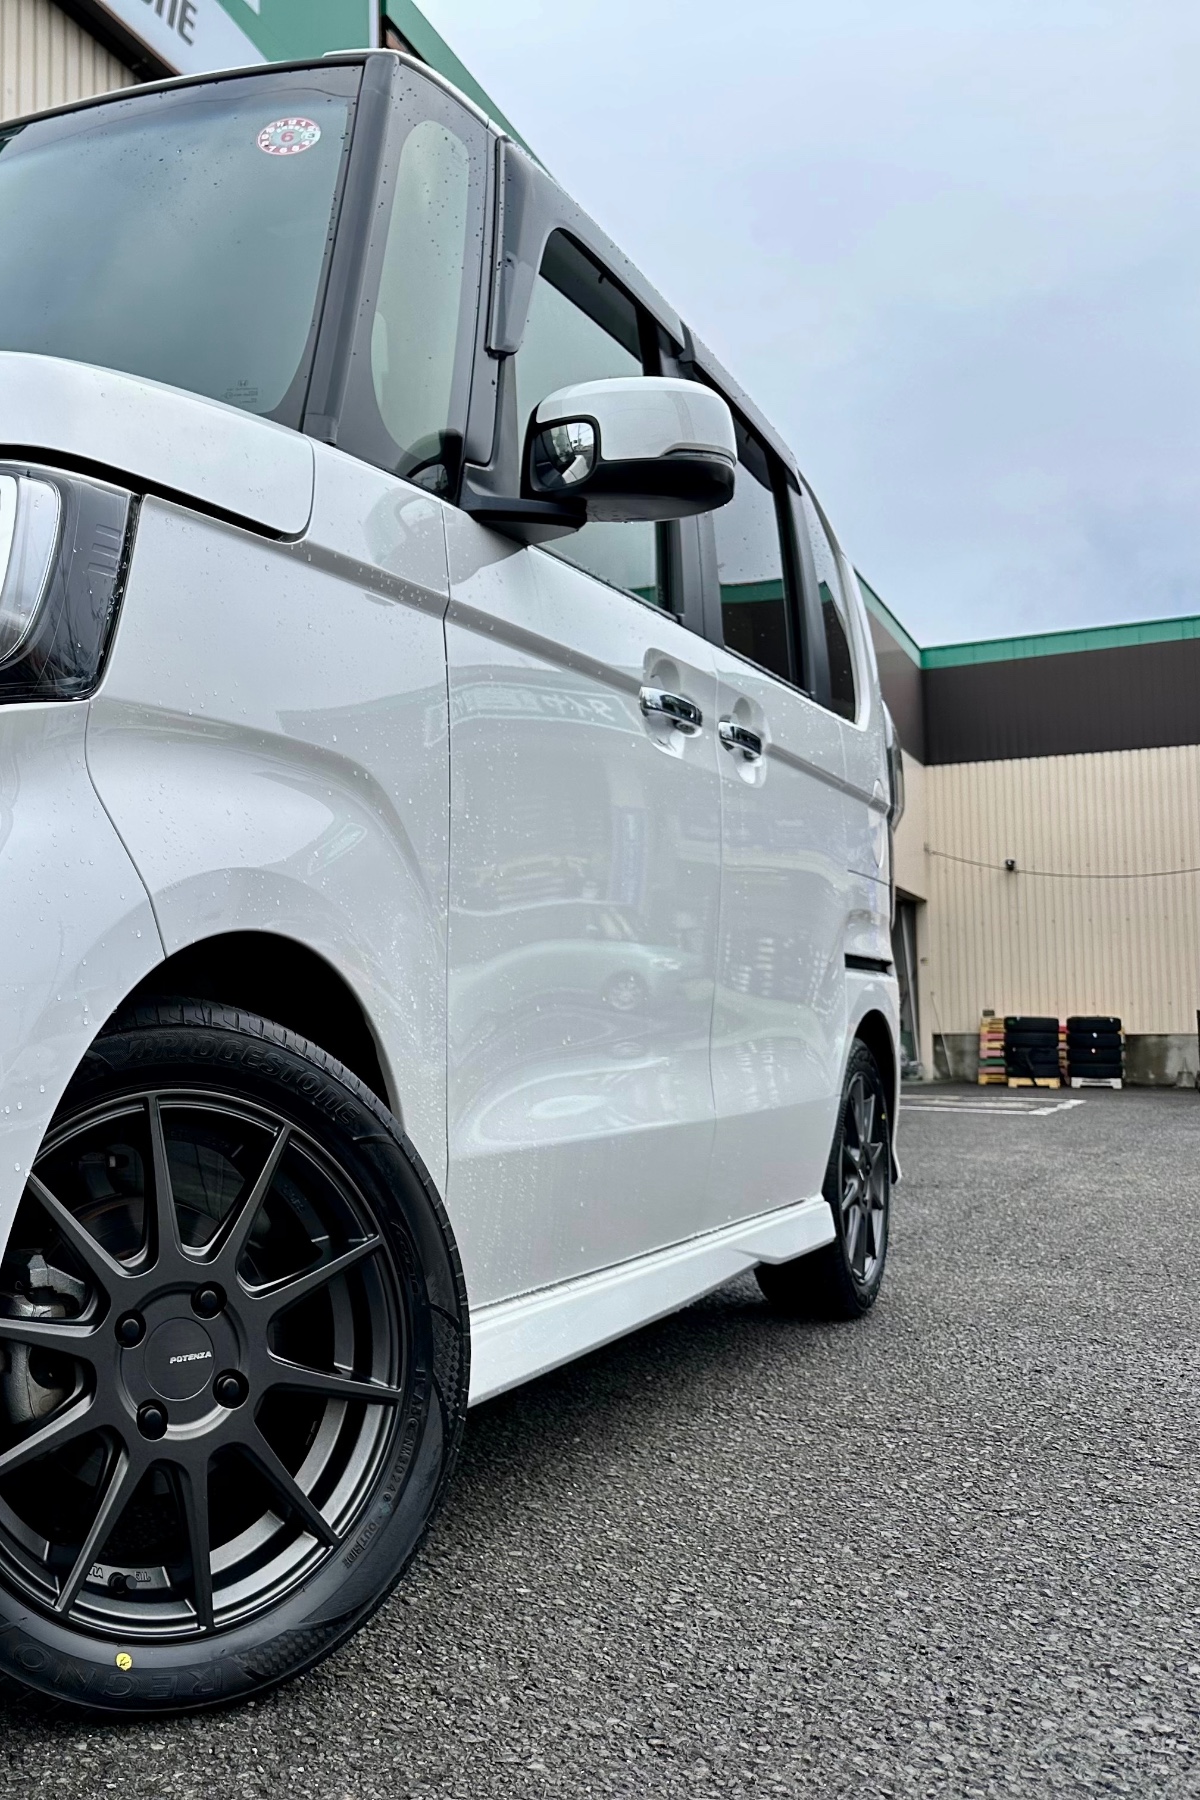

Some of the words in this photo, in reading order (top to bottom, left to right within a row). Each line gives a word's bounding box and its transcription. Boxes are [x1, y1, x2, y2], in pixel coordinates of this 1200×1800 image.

[280, 131, 295, 142] 6
[128, 1034, 362, 1126] BRIDGESTONE
[169, 1350, 213, 1365] POTENZA
[13, 1642, 224, 1701] REGNO
